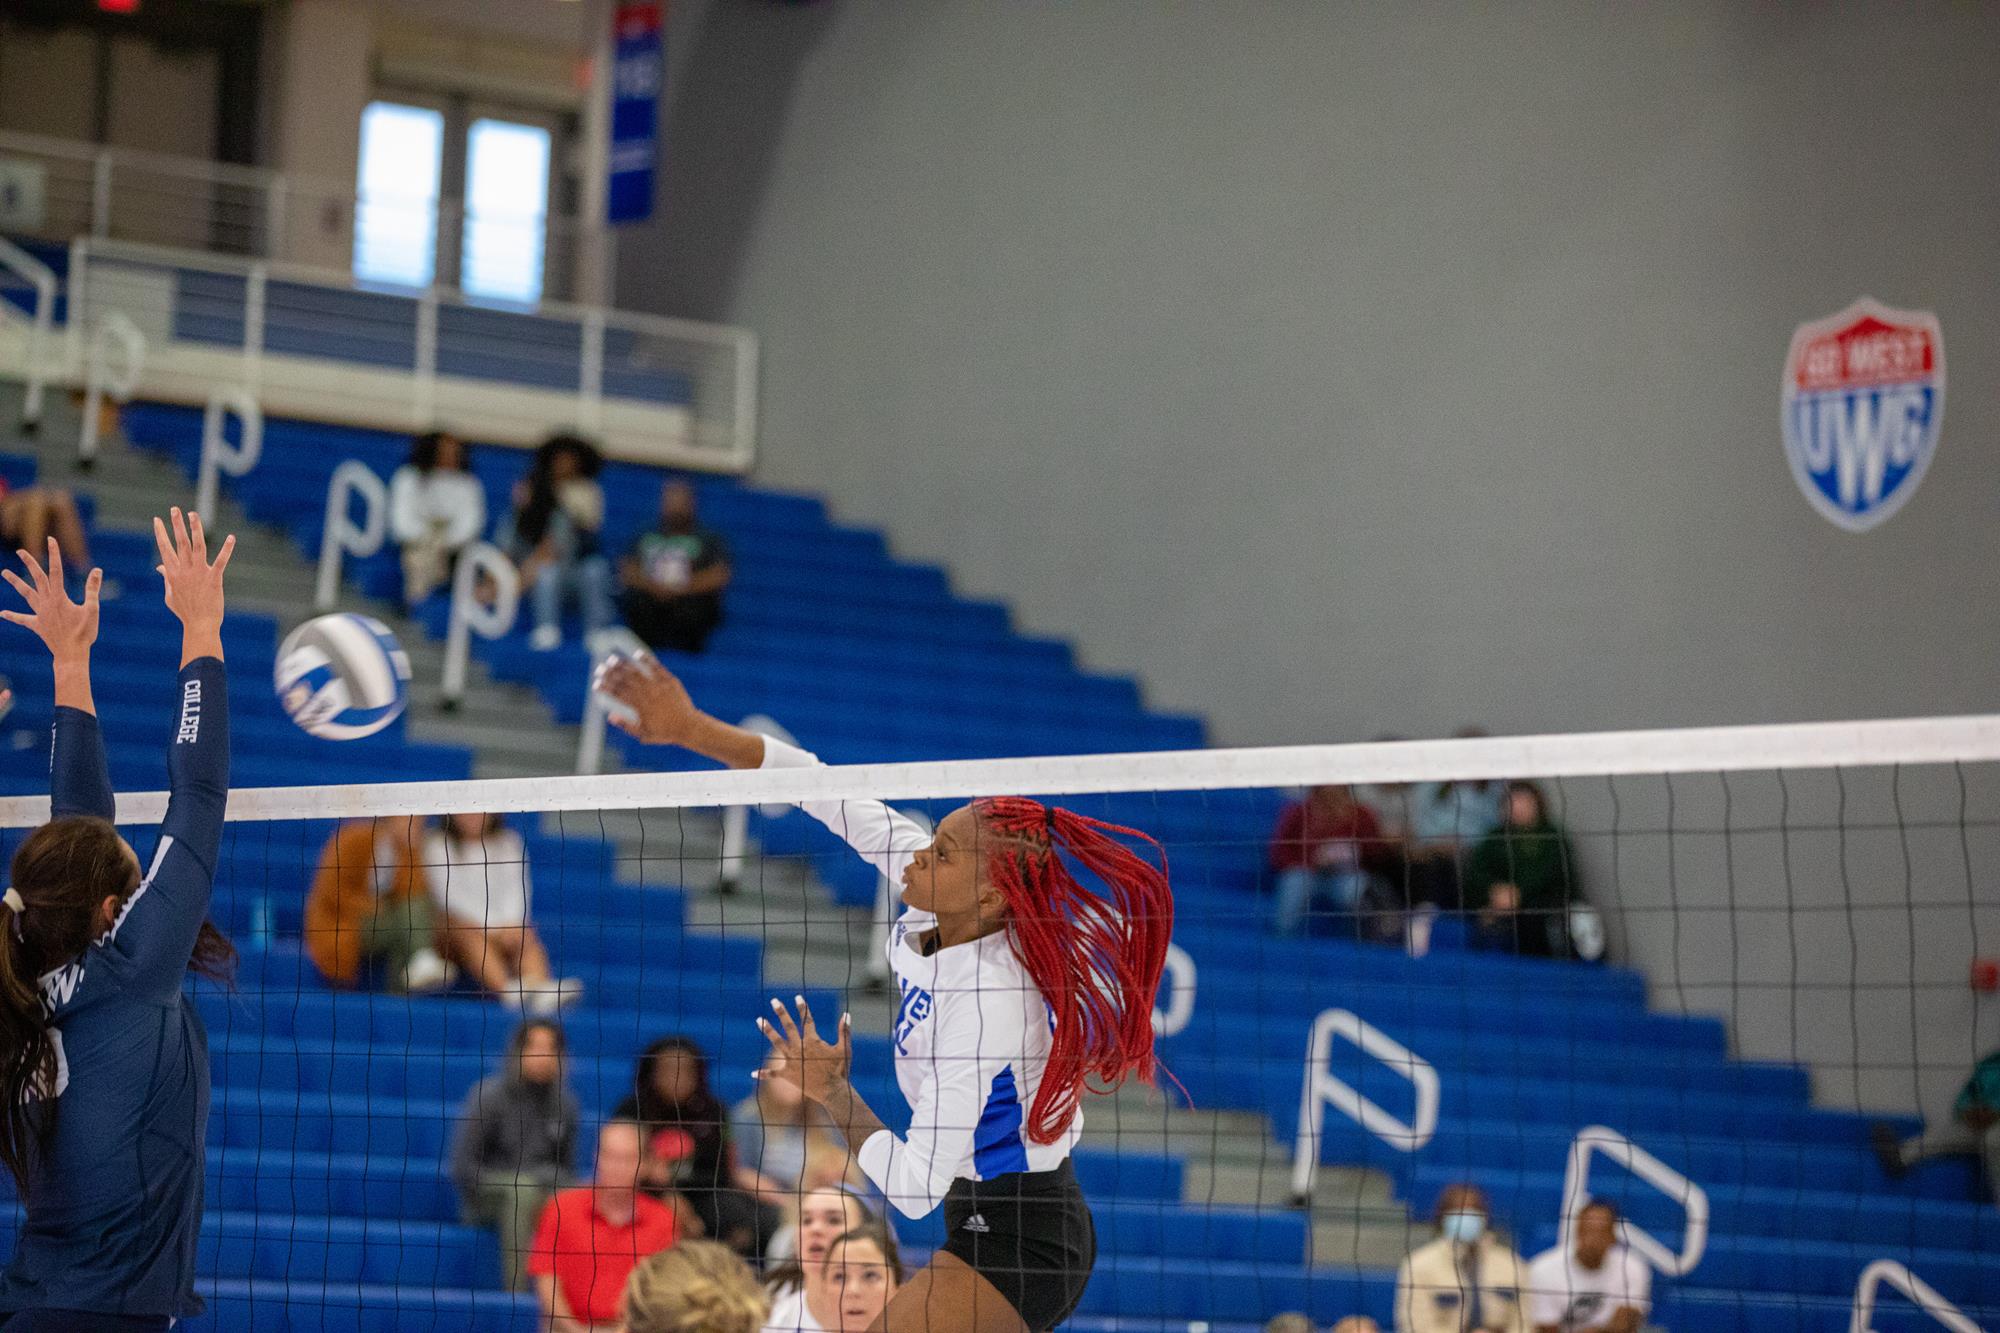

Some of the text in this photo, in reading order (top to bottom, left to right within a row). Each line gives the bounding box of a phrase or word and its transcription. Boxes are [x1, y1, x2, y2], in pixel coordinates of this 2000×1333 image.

[1848, 332, 1925, 375] WEST
[1798, 387, 1925, 503] UWG
[177, 680, 200, 744] COLLEGE
